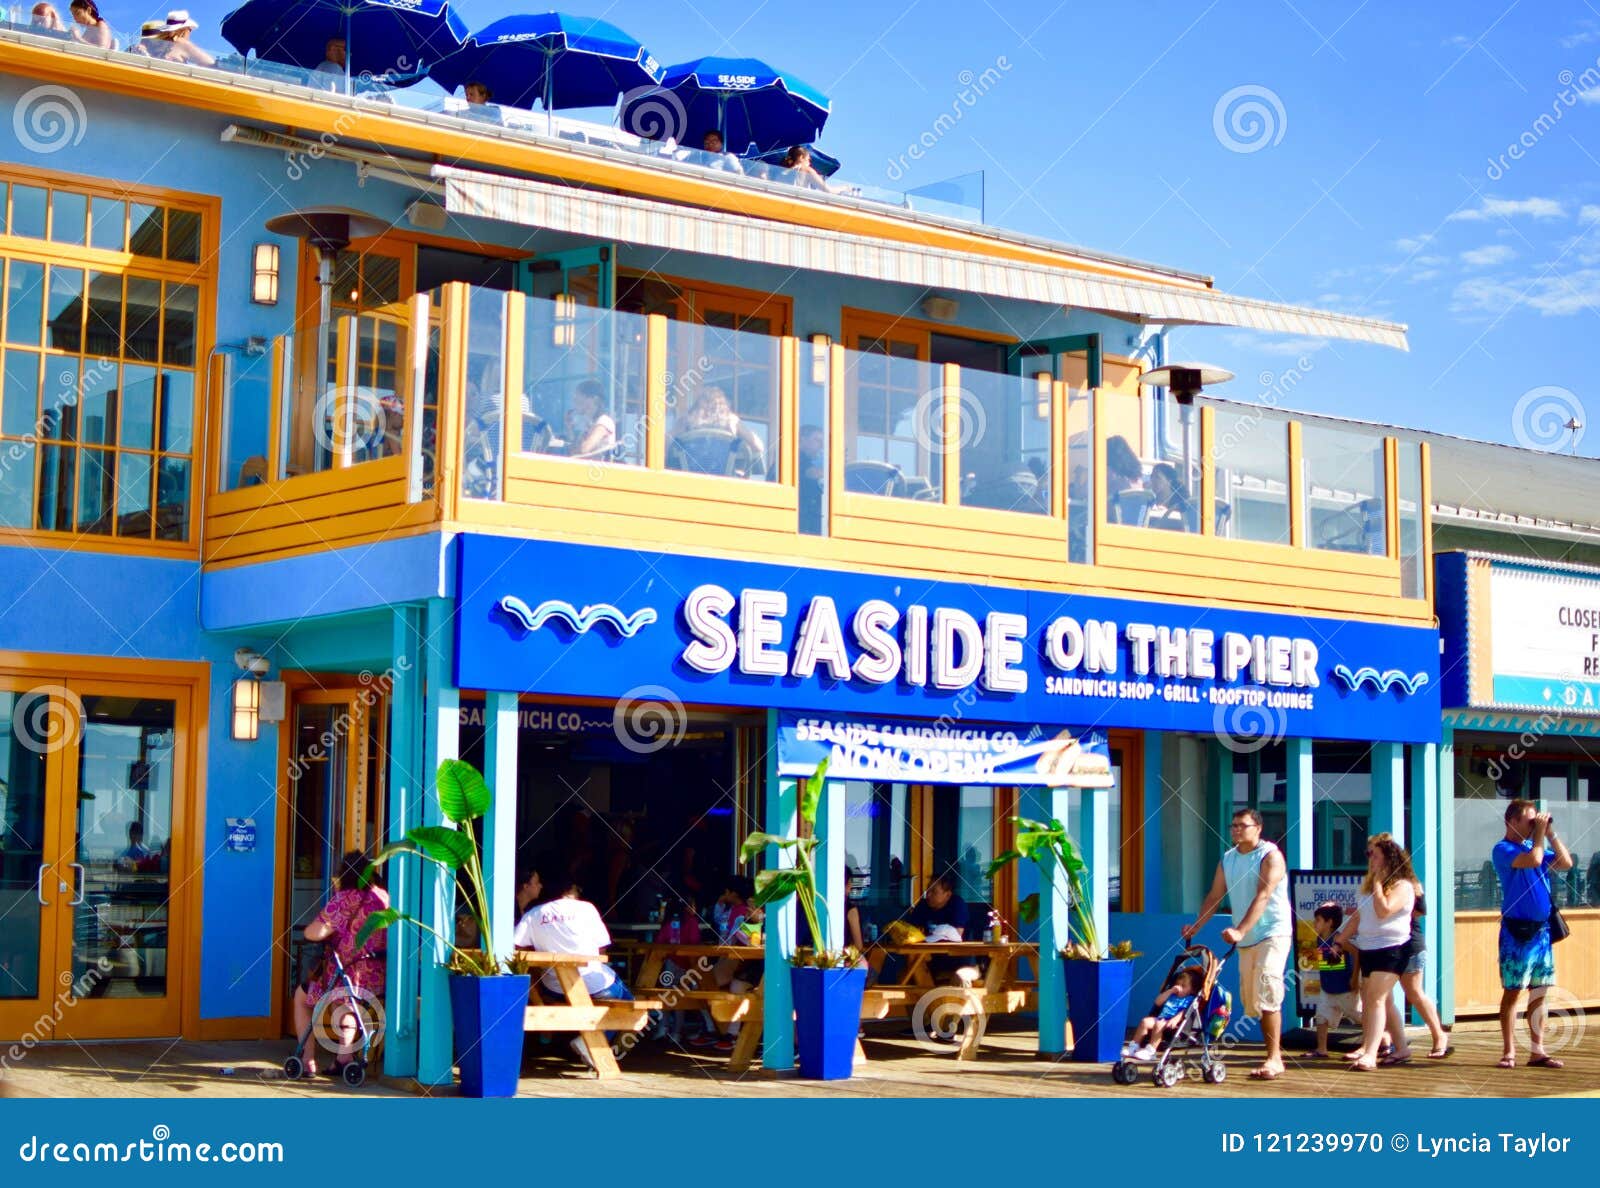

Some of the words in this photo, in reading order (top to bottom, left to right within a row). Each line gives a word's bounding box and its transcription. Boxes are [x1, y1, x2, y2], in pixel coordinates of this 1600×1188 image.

[718, 75, 757, 85] SEASIDE
[1558, 606, 1600, 629] CLOSE
[682, 584, 1028, 693] SEASIDE
[1046, 616, 1117, 674] ON
[1126, 623, 1216, 678] THE
[1222, 631, 1320, 689] PIER
[1045, 677, 1117, 698] SANDWICH
[1118, 682, 1155, 700] SHOP
[1163, 687, 1201, 704] GRILL
[1209, 689, 1265, 707] ROOFTOP
[1267, 691, 1315, 710] LOUNGE
[459, 706, 553, 731] SAICH
[556, 712, 584, 732] CO.
[796, 718, 878, 747] SEASIDE
[881, 724, 987, 752] SANDWICH
[831, 744, 904, 774] NOW
[1299, 901, 1316, 911] HOT
[1313, 892, 1356, 902] DELICIOUS
